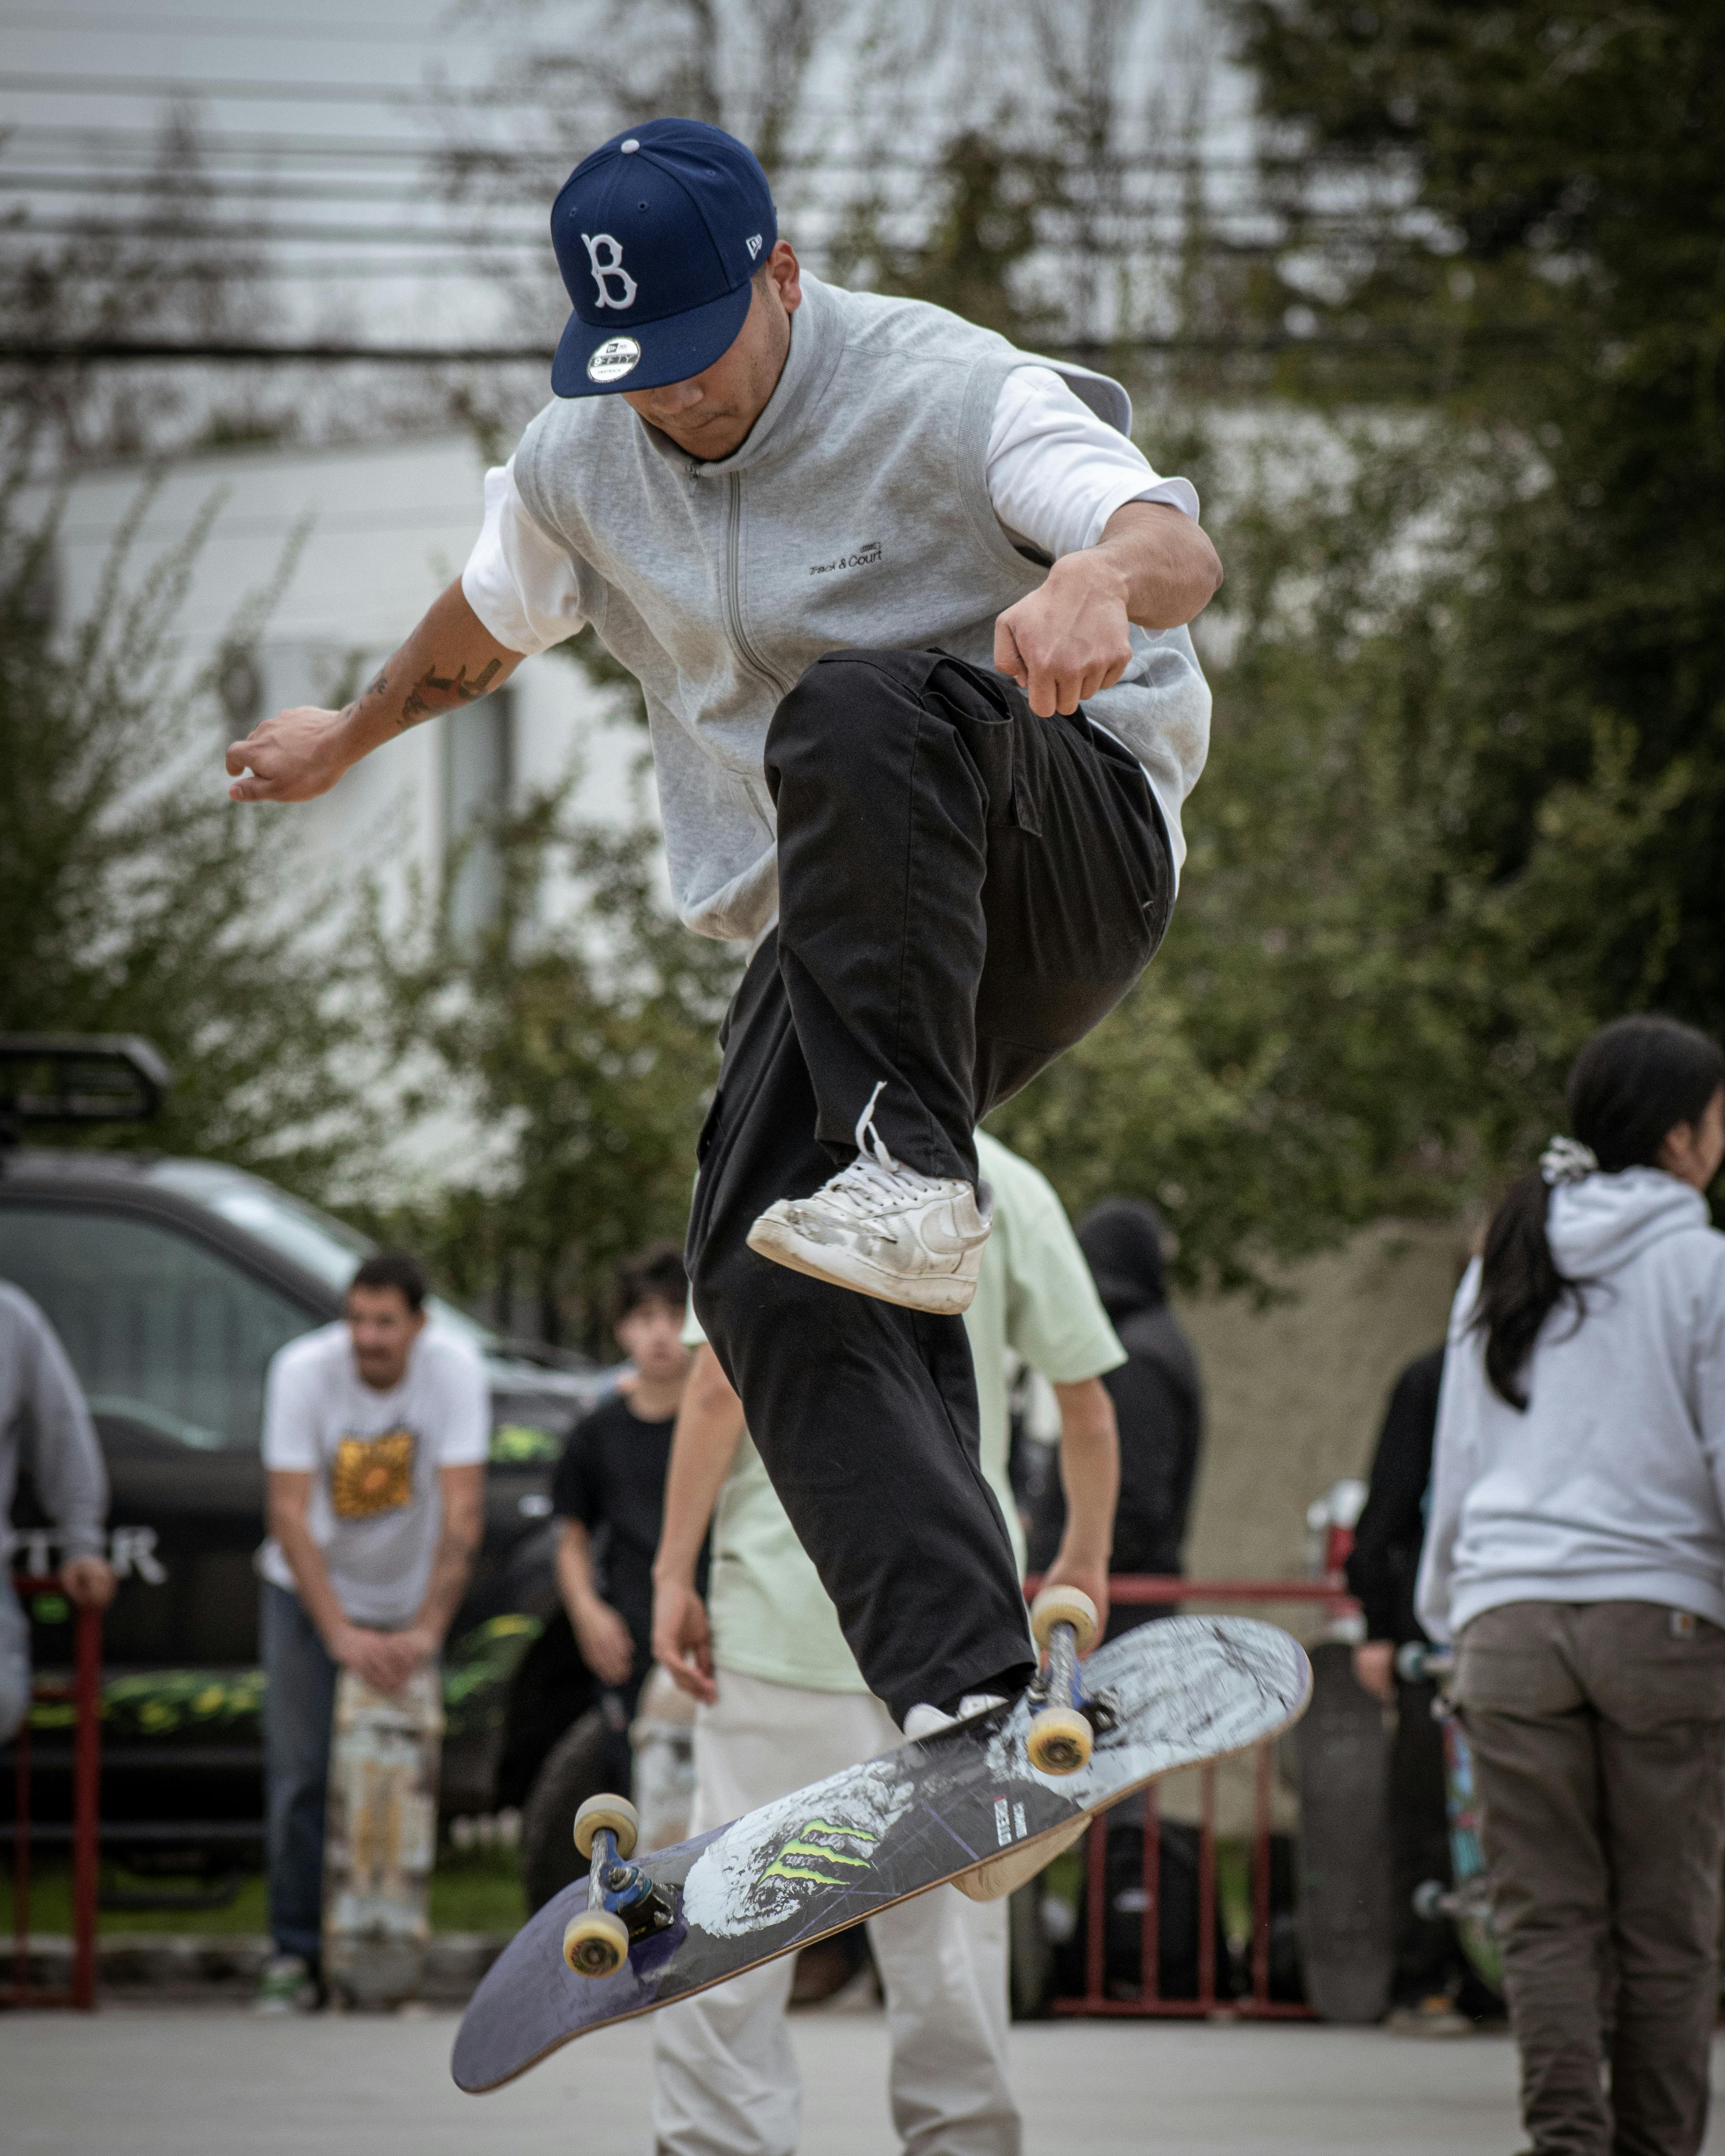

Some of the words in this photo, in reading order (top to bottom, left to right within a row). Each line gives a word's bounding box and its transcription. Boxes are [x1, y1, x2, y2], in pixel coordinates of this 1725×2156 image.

[581, 234, 638, 310] B
[839, 558, 846, 569] &
[848, 550, 882, 567] Court
